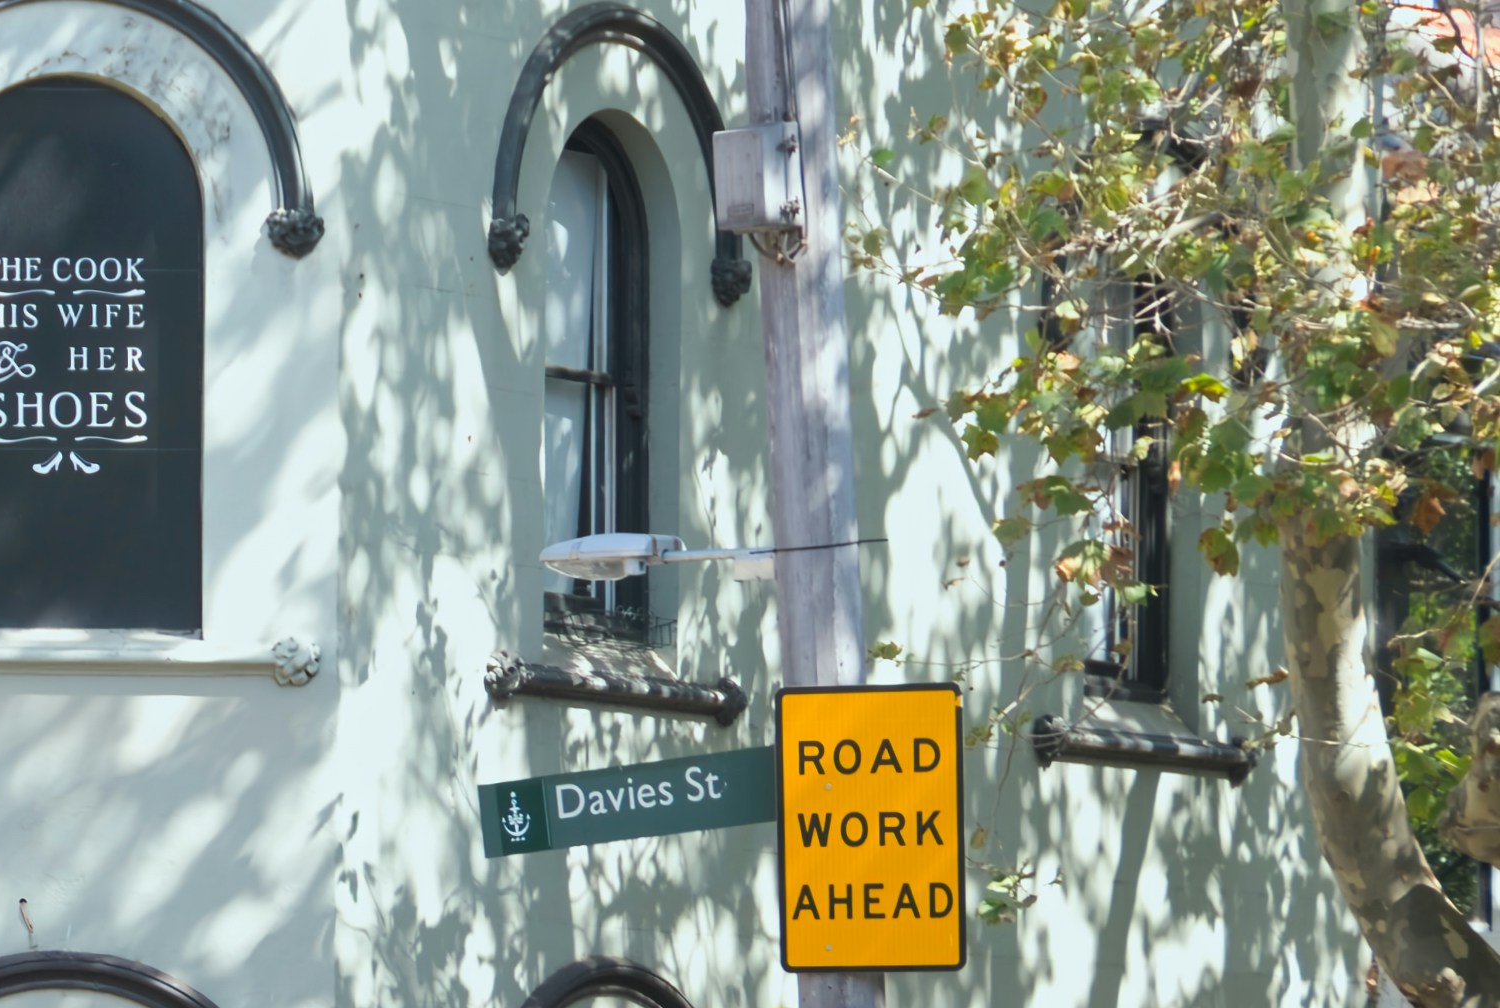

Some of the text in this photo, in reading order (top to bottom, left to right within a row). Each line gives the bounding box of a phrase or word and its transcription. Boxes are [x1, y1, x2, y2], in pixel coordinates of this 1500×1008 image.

[52, 257, 145, 282] COOK
[57, 304, 145, 328] WIFE
[67, 347, 145, 371] HER
[798, 738, 941, 776] ROAD
[555, 766, 722, 820] Davies St
[798, 810, 944, 848] WORK
[792, 882, 954, 920] AHEAD
